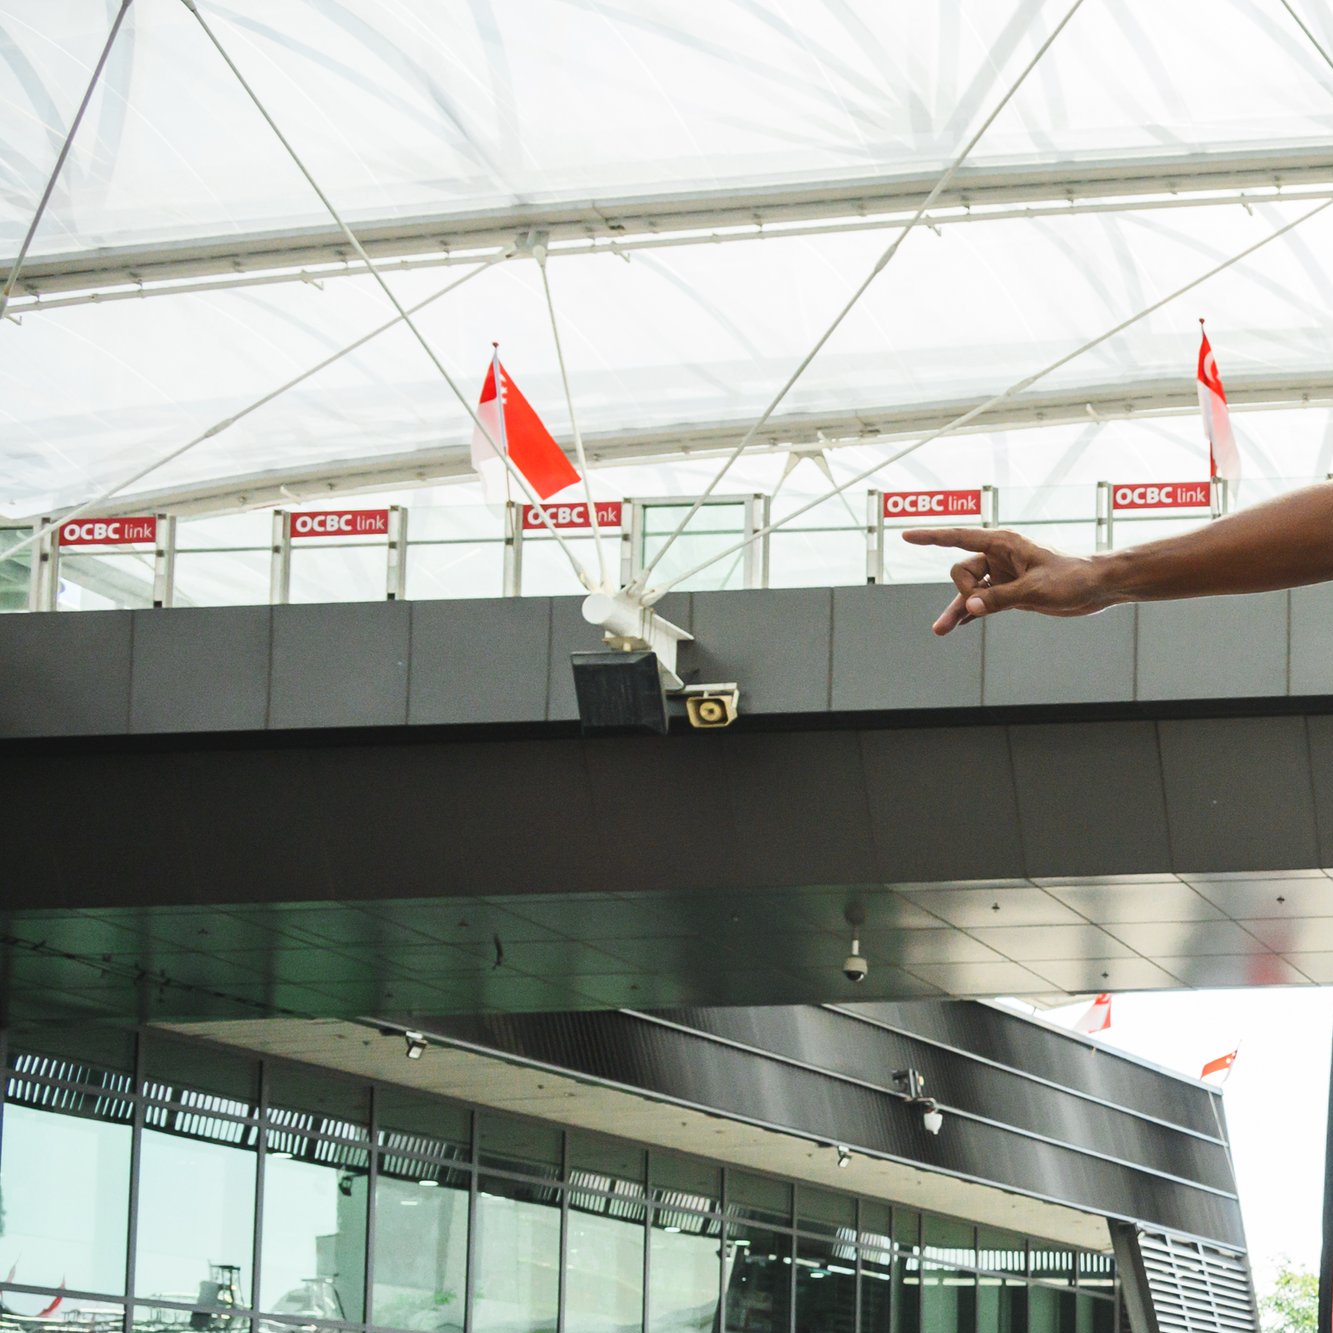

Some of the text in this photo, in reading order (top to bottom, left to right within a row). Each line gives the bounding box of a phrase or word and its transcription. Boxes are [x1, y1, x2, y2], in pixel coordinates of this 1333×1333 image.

[886, 494, 977, 513] OCBC link
[1115, 486, 1206, 506] OCBC link
[295, 514, 385, 533] OCBC link
[527, 506, 585, 525] OCBC
[63, 522, 152, 541] OCBC link
